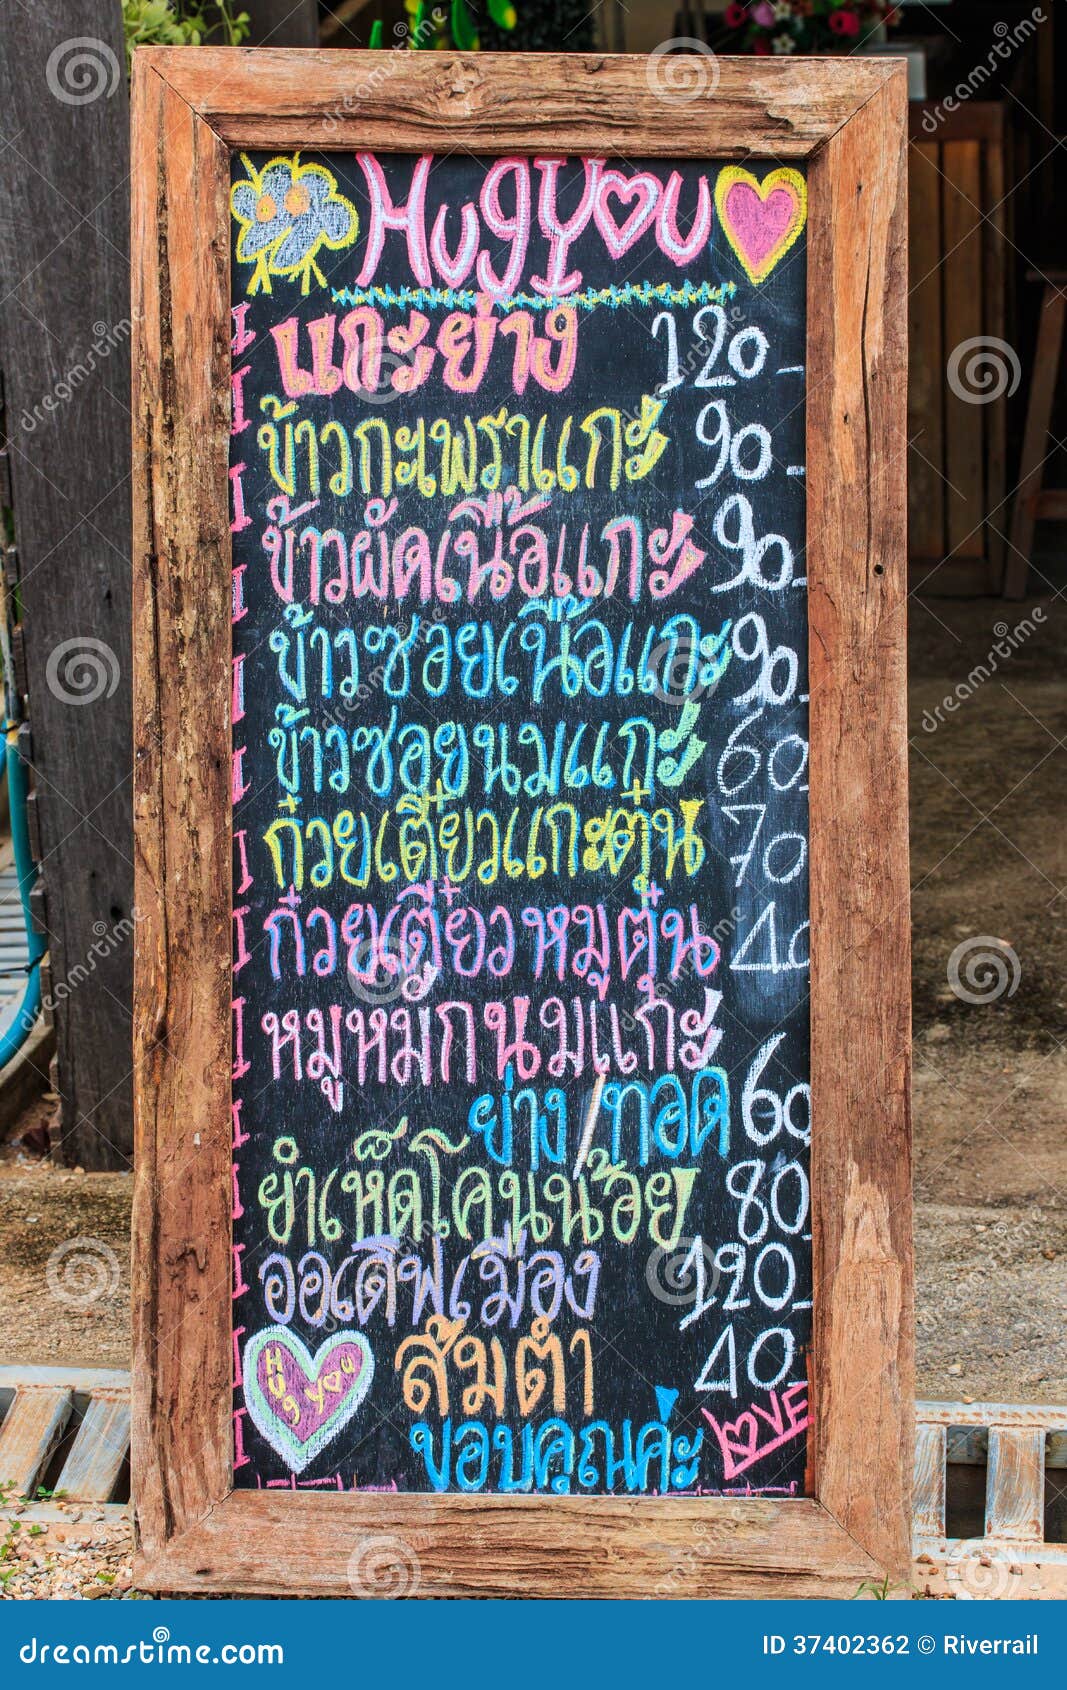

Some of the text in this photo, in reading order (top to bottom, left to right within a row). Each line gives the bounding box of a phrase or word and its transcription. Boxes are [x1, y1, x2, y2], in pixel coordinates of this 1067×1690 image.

[270, 296, 578, 396] แกะย่าง
[720, 804, 807, 887] 70
[395, 1313, 594, 1417] ส้มตำ
